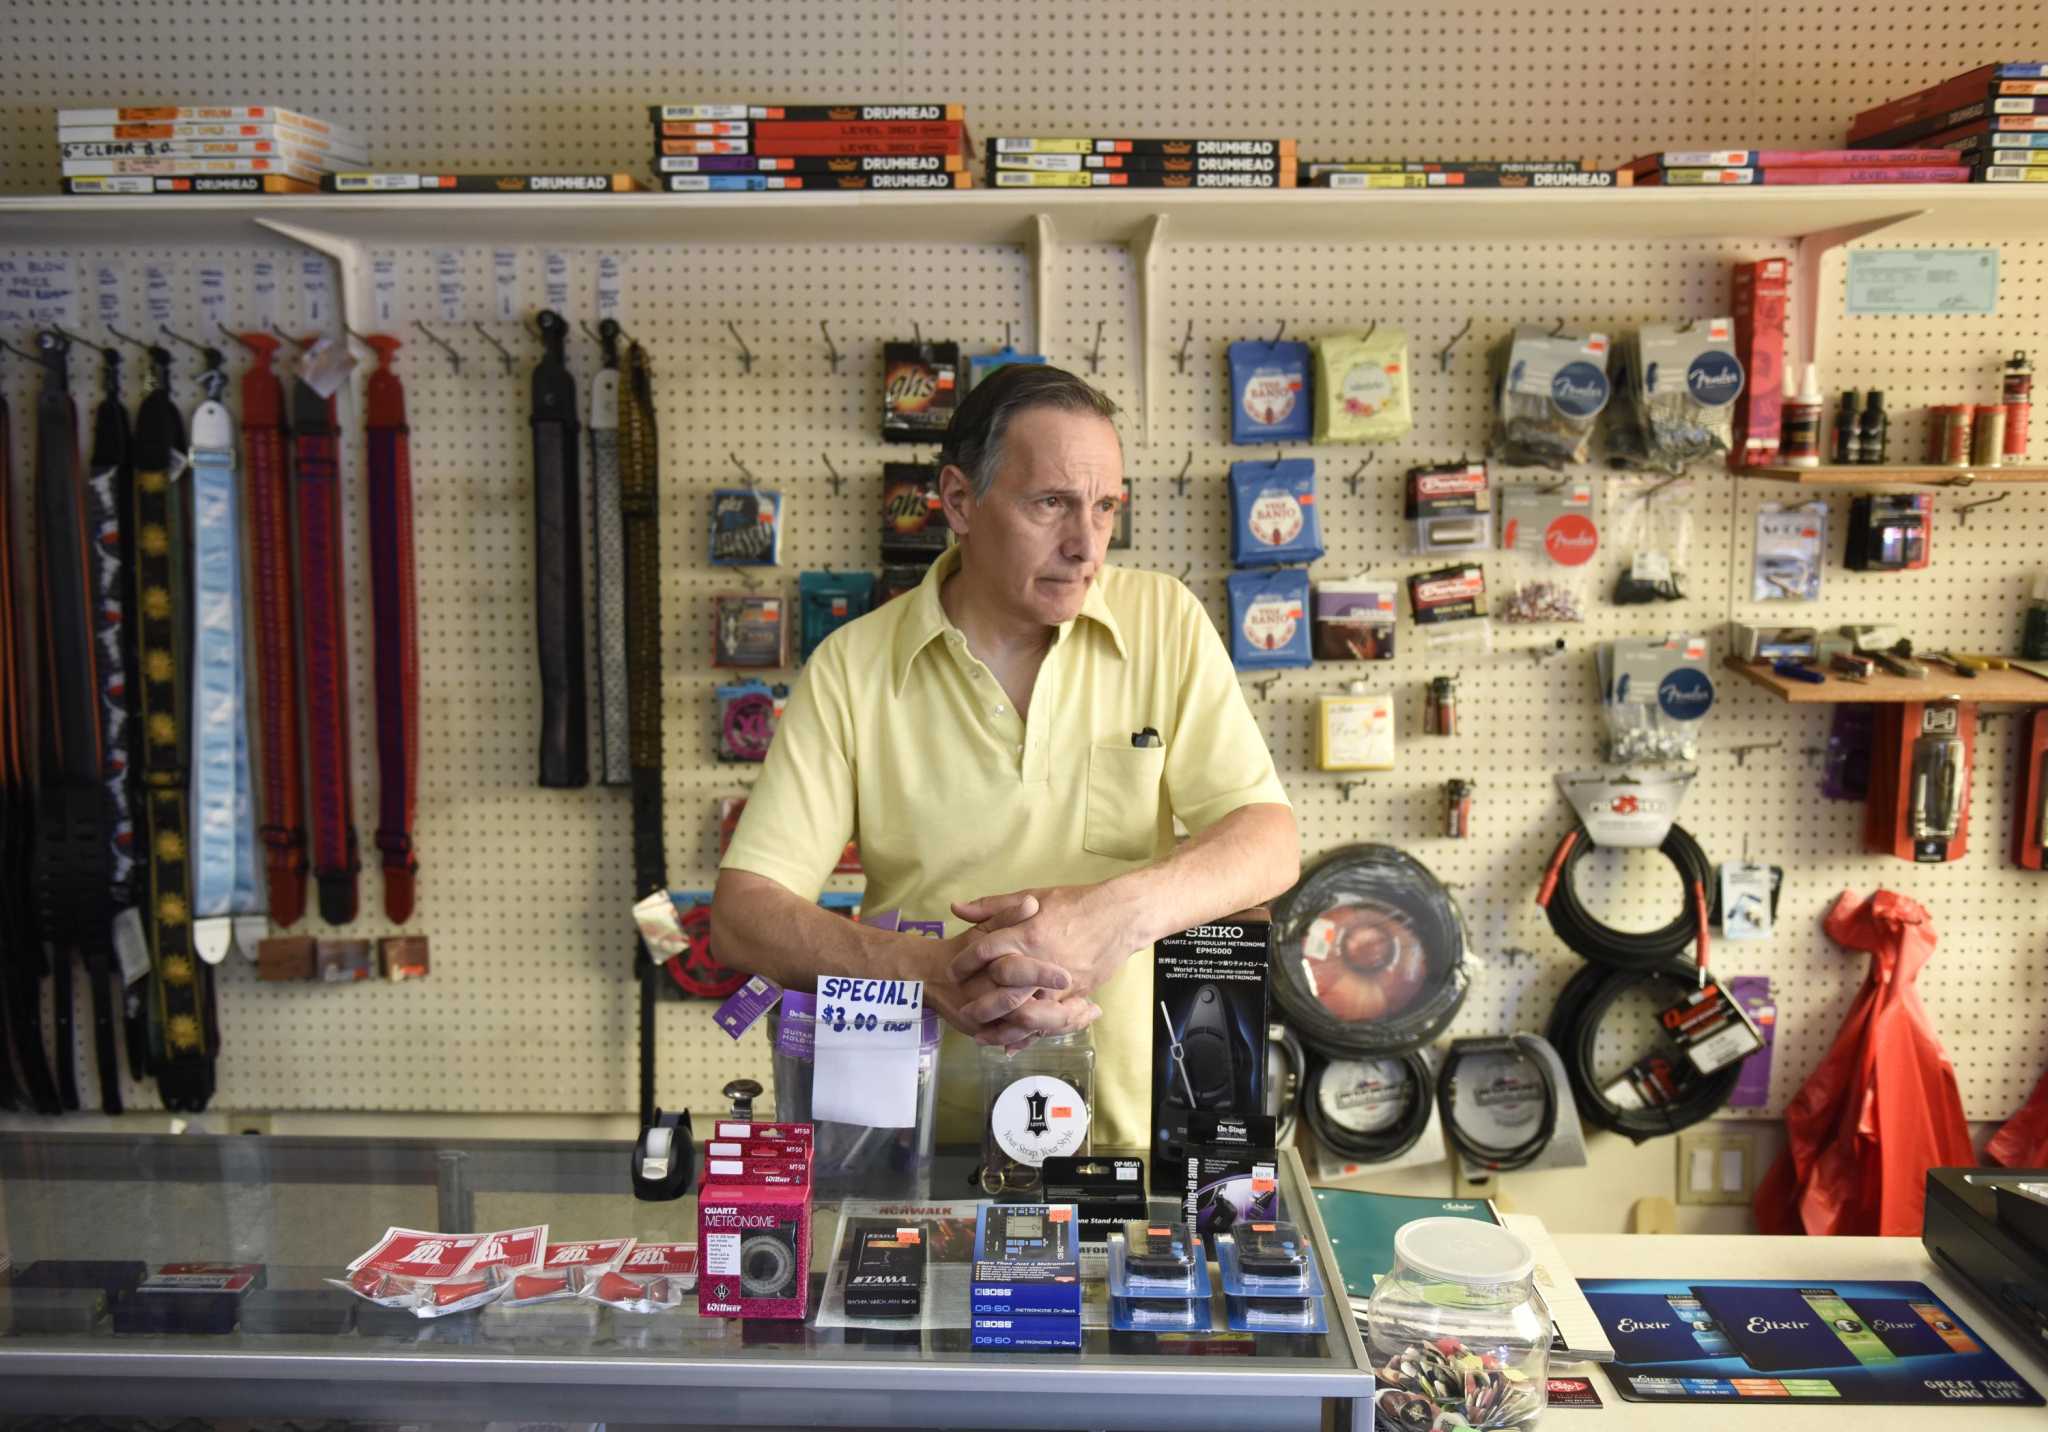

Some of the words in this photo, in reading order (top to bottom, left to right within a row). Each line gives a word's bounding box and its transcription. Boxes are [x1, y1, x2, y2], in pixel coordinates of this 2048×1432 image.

[863, 107, 940, 120] DRUMHEAD
[1197, 142, 1274, 155] DRUMHEAD
[862, 158, 939, 170] DRUMHEAD
[1198, 159, 1274, 171] DRUMHEAD
[195, 179, 258, 190] DRUMHEAD
[531, 177, 607, 190] DRUMHEAD
[872, 175, 949, 188] DRUMHEAD
[1197, 174, 1273, 187] DRUMHEAD
[1533, 171, 1610, 187] DRUMHEAD
[1690, 367, 1739, 389] Fender
[1555, 377, 1603, 396] Fender
[1550, 532, 1595, 548] Fender
[1660, 683, 1709, 703] Fender
[1185, 926, 1244, 938] SEIKO
[1196, 947, 1232, 955] EPM5000
[1173, 966, 1198, 974] World's
[1200, 966, 1212, 974] first
[821, 978, 920, 1010] SPECIAL!
[821, 1003, 878, 1032] $3.00
[1032, 1101, 1043, 1120] L
[1216, 1124, 1247, 1134] On-Stage
[1017, 1144, 1039, 1160] Strap
[1187, 1157, 1199, 1179] amp
[705, 1215, 775, 1228] METRONOME
[864, 1275, 907, 1283] TAMA
[983, 1288, 1012, 1296] BOSS
[707, 1302, 742, 1312] Wittner
[983, 1320, 1012, 1328] BOSS
[1617, 1317, 1671, 1334] Elixir
[1746, 1316, 1810, 1335] Elixir
[1872, 1319, 1917, 1332] Elixir
[1923, 1380, 1976, 1390] GREAT
[1983, 1380, 2023, 1390] TONE
[1942, 1389, 1983, 1399] LONG
[1991, 1389, 2024, 1399] LIFE
